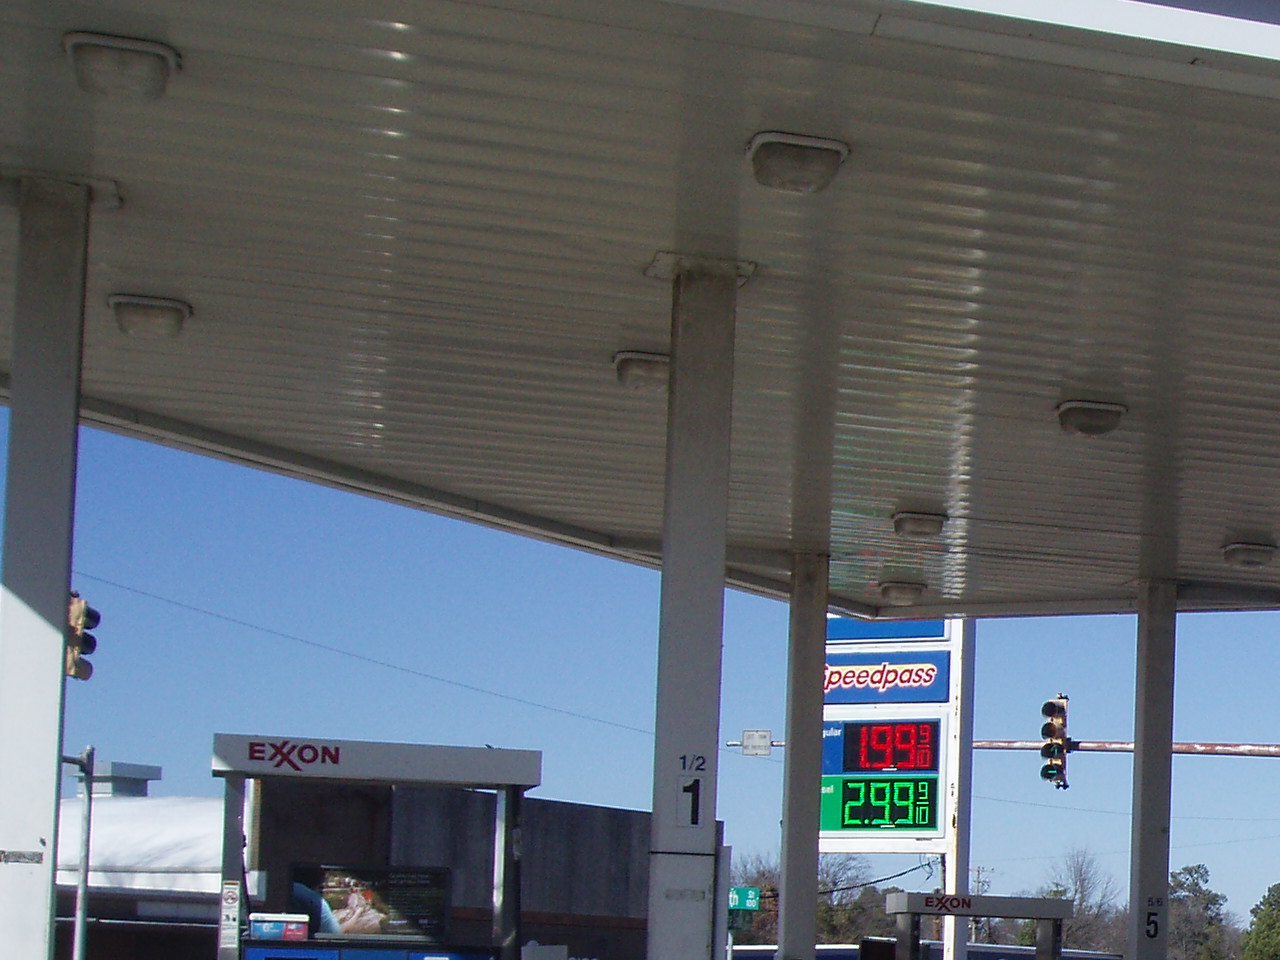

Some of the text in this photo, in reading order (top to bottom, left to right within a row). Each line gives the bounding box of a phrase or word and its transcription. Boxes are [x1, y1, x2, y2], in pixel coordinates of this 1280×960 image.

[249, 741, 340, 771] EXXON
[679, 755, 706, 771] 1/2
[683, 779, 700, 825] 1
[729, 888, 739, 908] th
[925, 895, 971, 912] EXXON
[1145, 912, 1158, 939] 5
